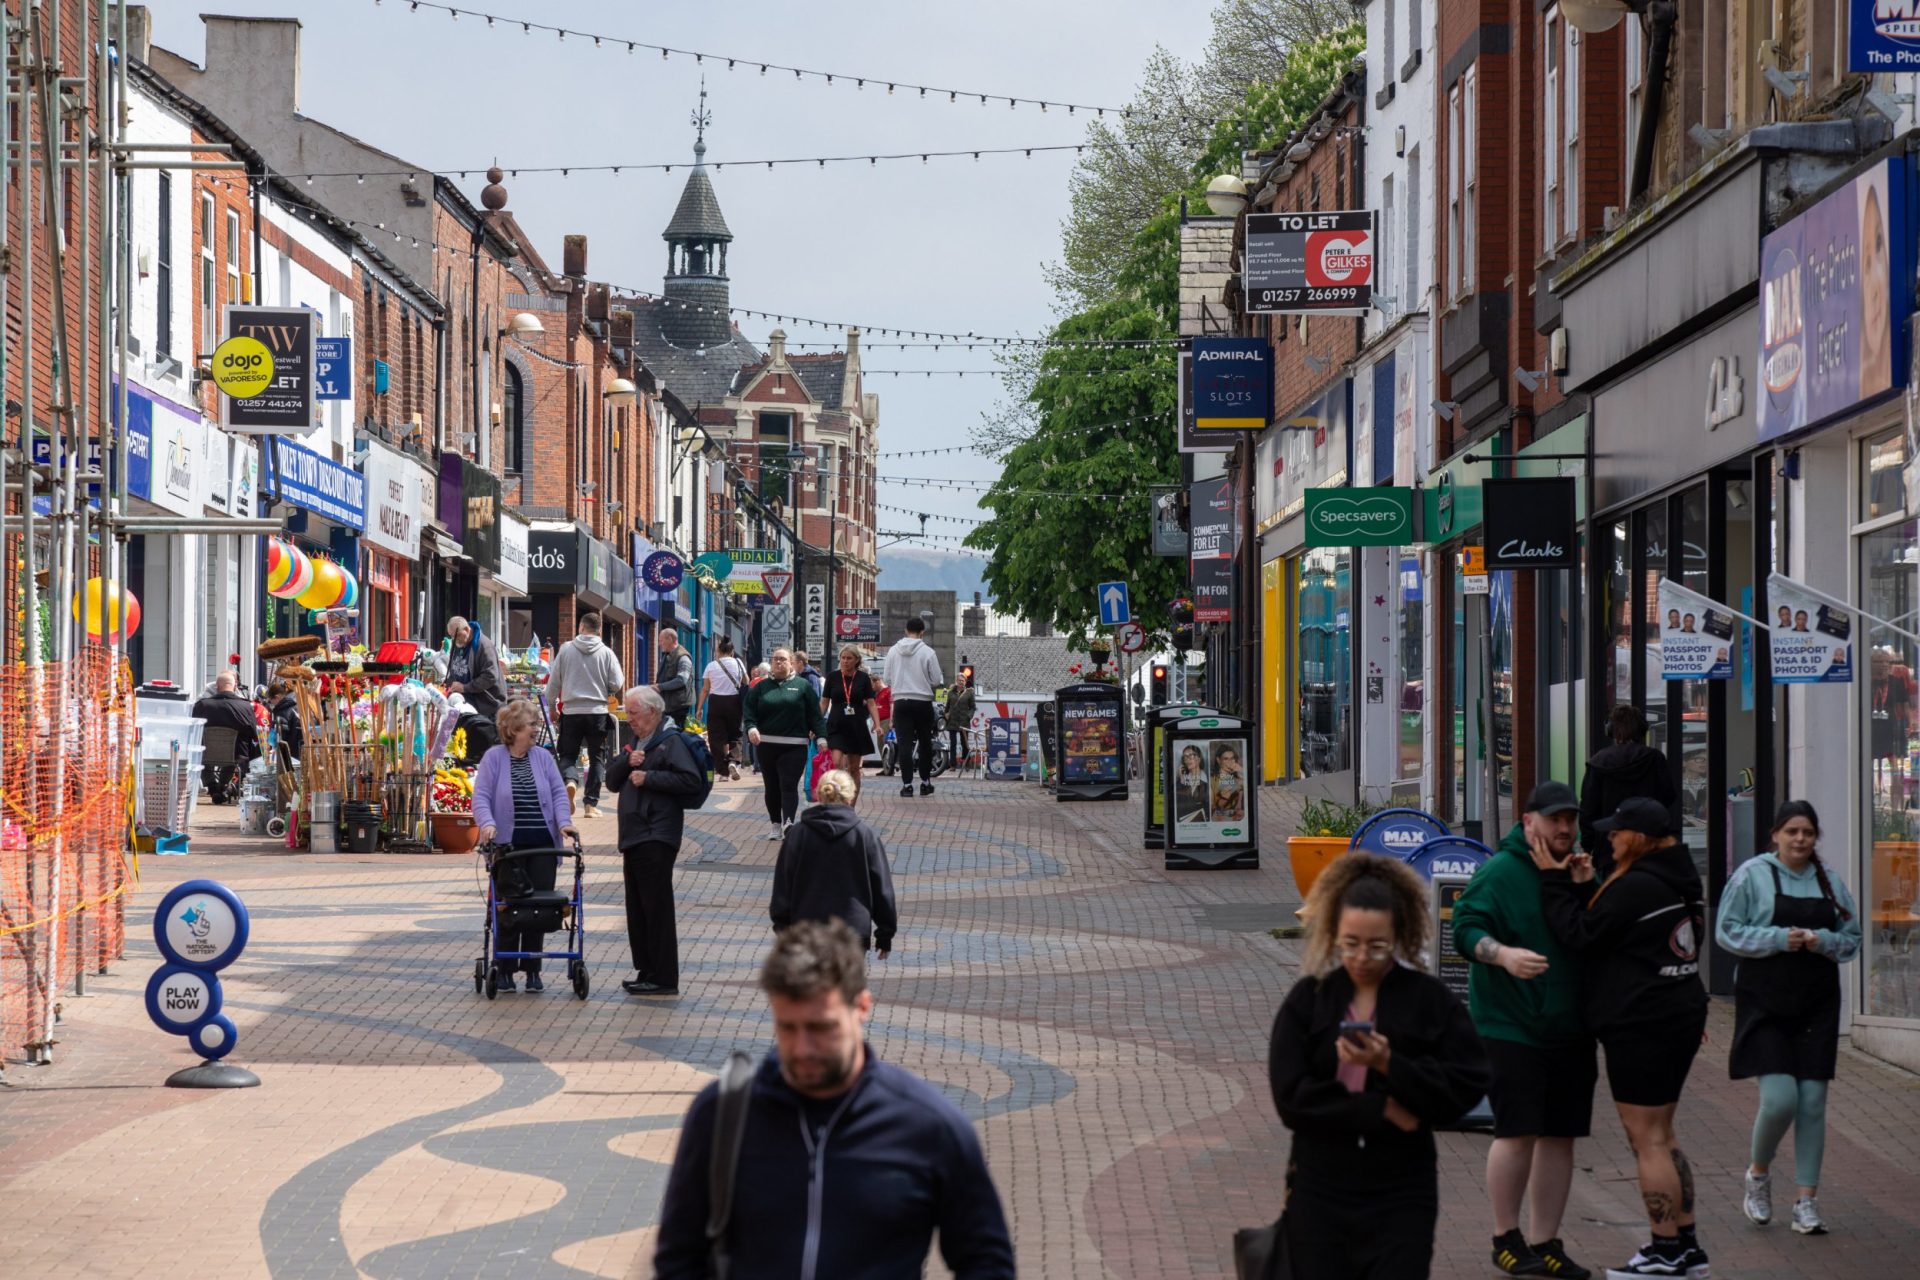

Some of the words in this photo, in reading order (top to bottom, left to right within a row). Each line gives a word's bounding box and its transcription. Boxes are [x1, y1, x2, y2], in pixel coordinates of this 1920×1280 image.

[1885, 24, 1920, 33] SPIE
[1867, 50, 1893, 64] The
[1279, 217, 1304, 231] TO
[1308, 215, 1340, 230] LET
[1327, 256, 1368, 269] GILKES
[1807, 249, 1826, 306] The
[1828, 235, 1856, 300] Photo
[1262, 290, 1301, 302] 01257
[1307, 288, 1357, 301] 266999
[1764, 264, 1802, 349] MAX
[1816, 311, 1849, 386] Expert
[273, 356, 301, 364] estwell
[1198, 350, 1264, 361] ADMIRAL
[223, 354, 262, 370] dojo
[220, 375, 268, 383] VAPORESSO
[269, 376, 300, 389] ET
[1210, 392, 1252, 401] SLOTS
[298, 449, 318, 491] TOWN
[319, 461, 346, 503] DISCOUNT
[347, 473, 363, 509] STORE
[1320, 510, 1397, 524] Specsavers
[1193, 523, 1229, 537] COMMERCIAL
[1193, 537, 1207, 550] FOR
[1207, 535, 1221, 549] LET
[1497, 539, 1564, 559] Clarks
[528, 545, 566, 568] rdo's
[1211, 585, 1228, 596] FOR
[808, 586, 821, 632] DANCE
[1663, 637, 1700, 646] INSTANT
[1772, 637, 1814, 645] INSTANT
[1664, 645, 1712, 653] PASSPORT
[1774, 646, 1828, 655] PASSPORT
[1697, 654, 1707, 662] ID
[1774, 656, 1798, 665] VISA
[1801, 656, 1808, 664] &
[1810, 656, 1822, 664] ID
[1664, 663, 1703, 671] PHOTOS
[1774, 666, 1817, 674] PHOTOS
[1065, 710, 1085, 718] NEW
[1086, 709, 1118, 718] GAMES
[1383, 831, 1424, 843] MAX
[1432, 860, 1476, 874] MAX
[166, 987, 200, 998] PLAY
[166, 999, 200, 1009] NOW
